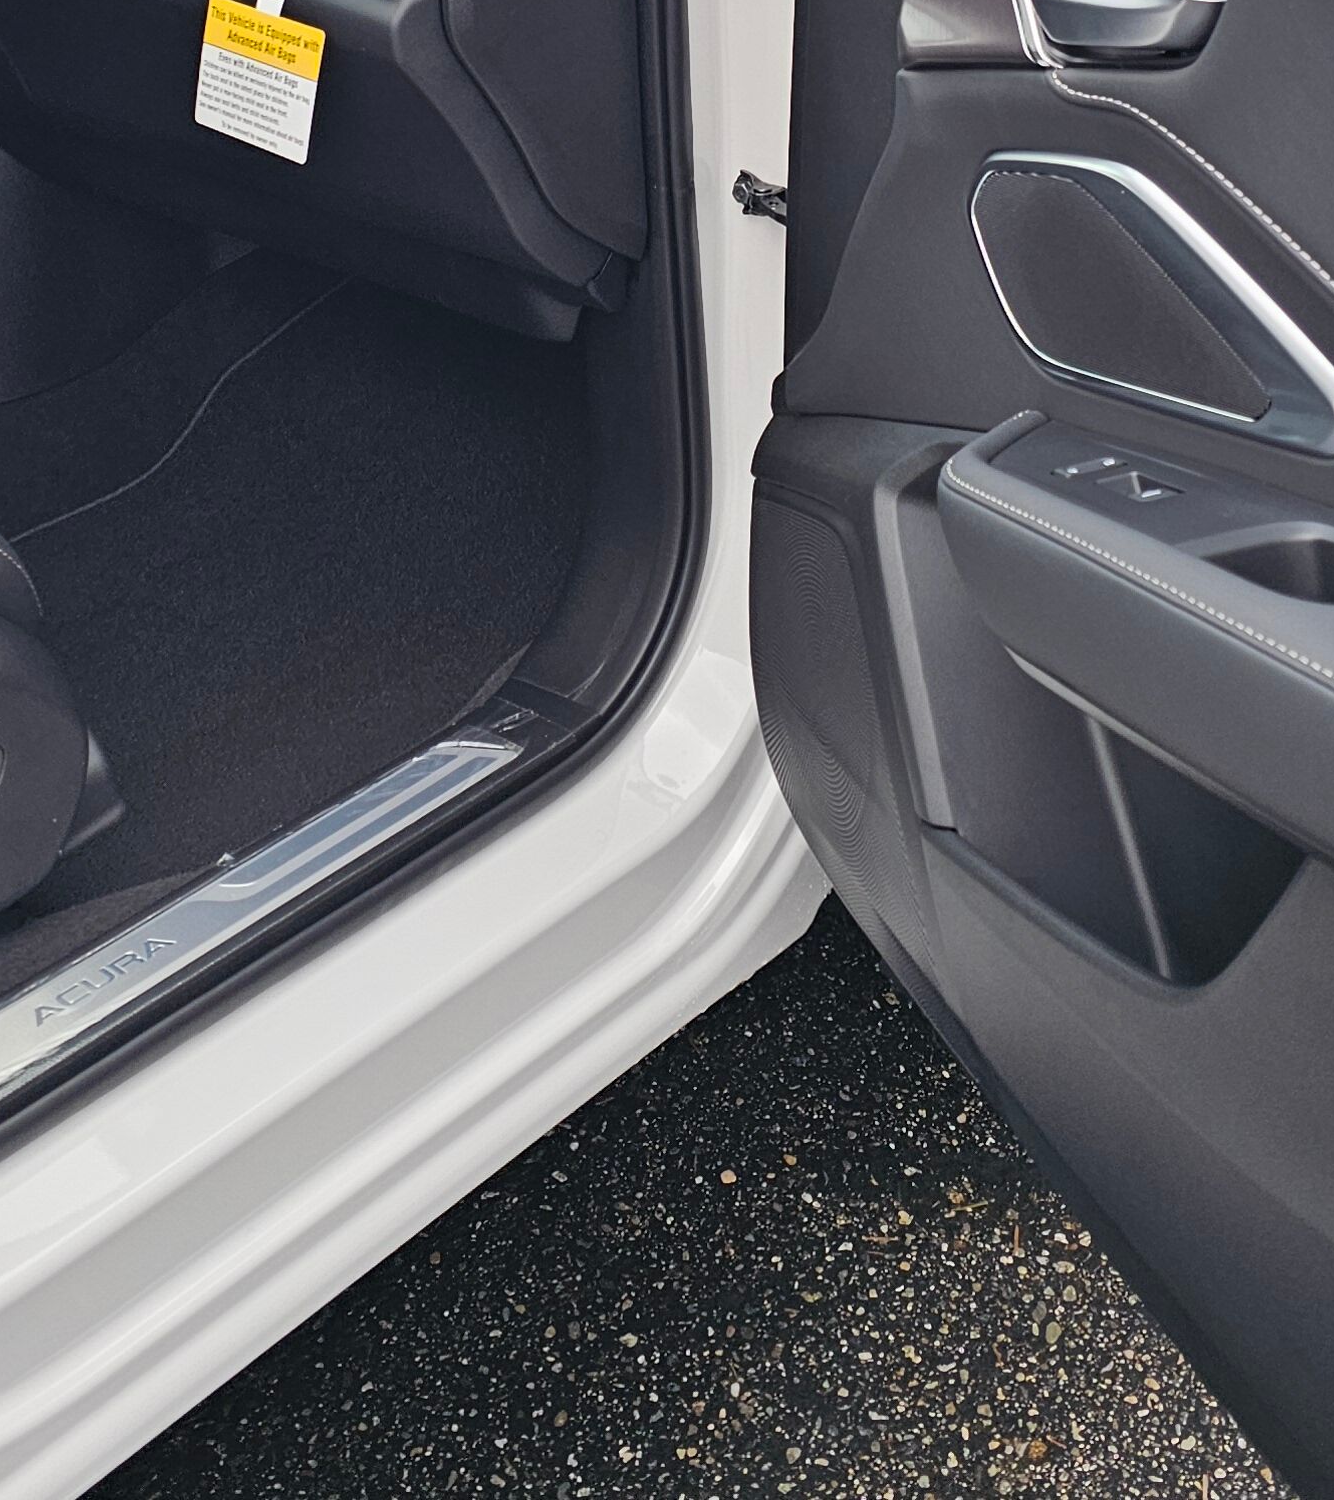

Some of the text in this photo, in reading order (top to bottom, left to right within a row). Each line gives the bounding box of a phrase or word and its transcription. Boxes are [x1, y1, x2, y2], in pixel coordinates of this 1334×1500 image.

[212, 5, 226, 20] This
[228, 12, 255, 31] Vehicle
[265, 25, 301, 47] Equipped
[227, 29, 296, 65] Advanced Air Bags
[34, 937, 177, 1027] ACURA
